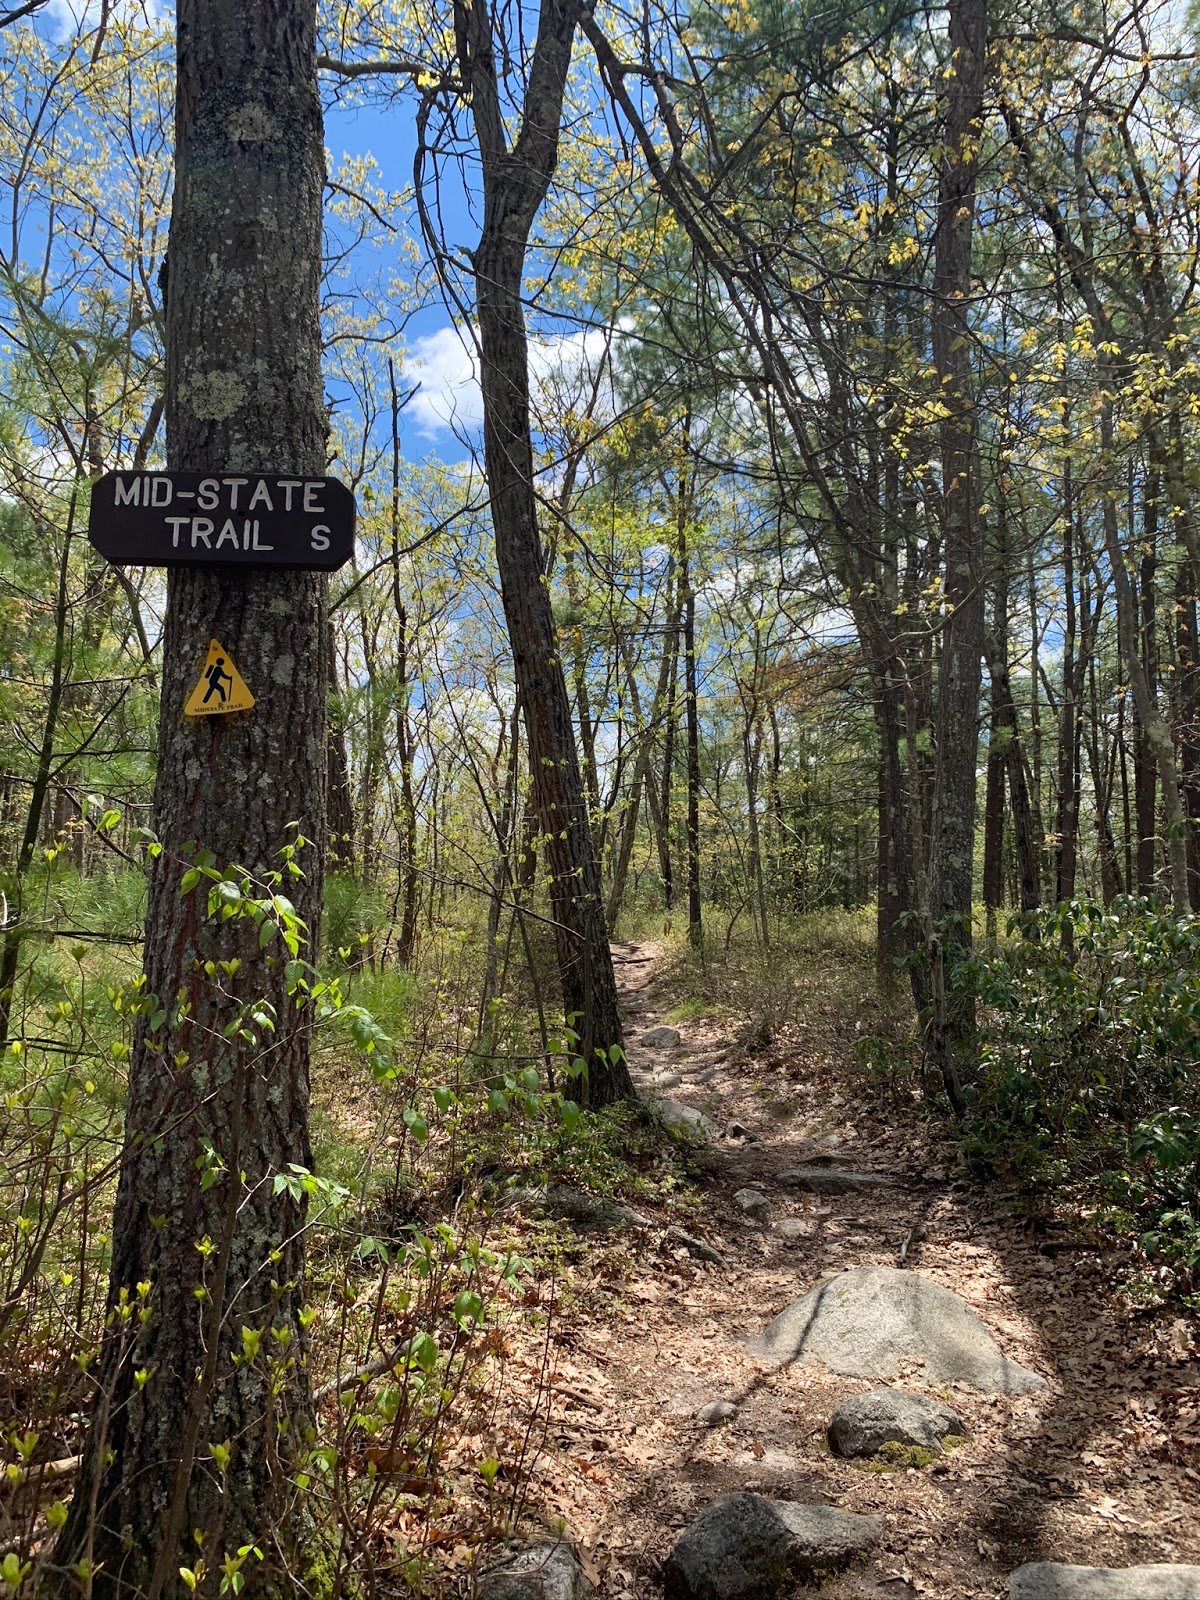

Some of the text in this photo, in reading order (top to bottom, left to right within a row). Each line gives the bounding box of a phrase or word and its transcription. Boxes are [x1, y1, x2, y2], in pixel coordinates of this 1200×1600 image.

[114, 476, 326, 513] MID-STATE
[164, 517, 331, 551] TRAIL S
